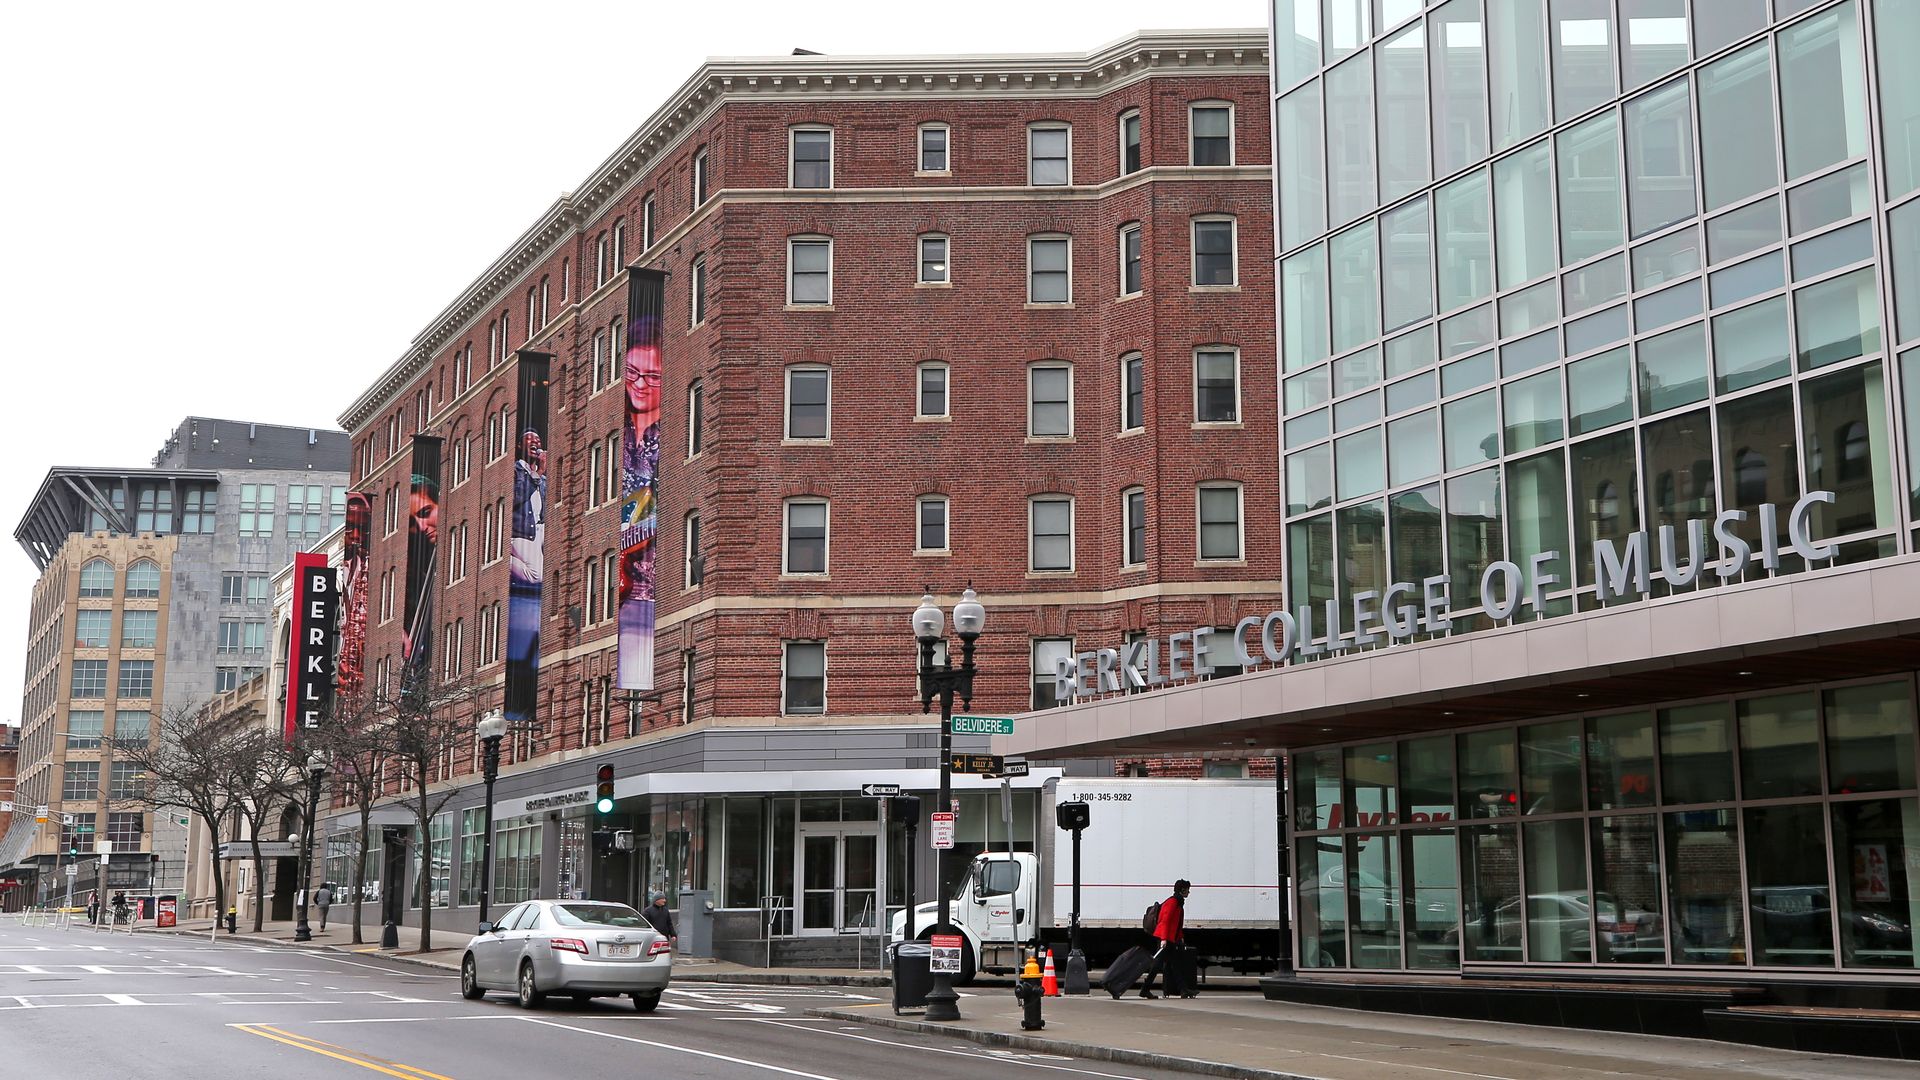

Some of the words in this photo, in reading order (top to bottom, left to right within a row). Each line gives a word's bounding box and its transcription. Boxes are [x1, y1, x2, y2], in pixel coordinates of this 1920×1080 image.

[1055, 626, 1216, 700] BERKLEE
[1234, 574, 1453, 665] COLLEGE
[1481, 550, 1560, 620] OF
[1593, 490, 1840, 601] MUSIC
[304, 575, 327, 736] BERKLE
[955, 717, 1003, 733] BELVIDERE
[1010, 765, 1024, 773] WAY
[1072, 793, 1133, 801] 1-800-345-9282
